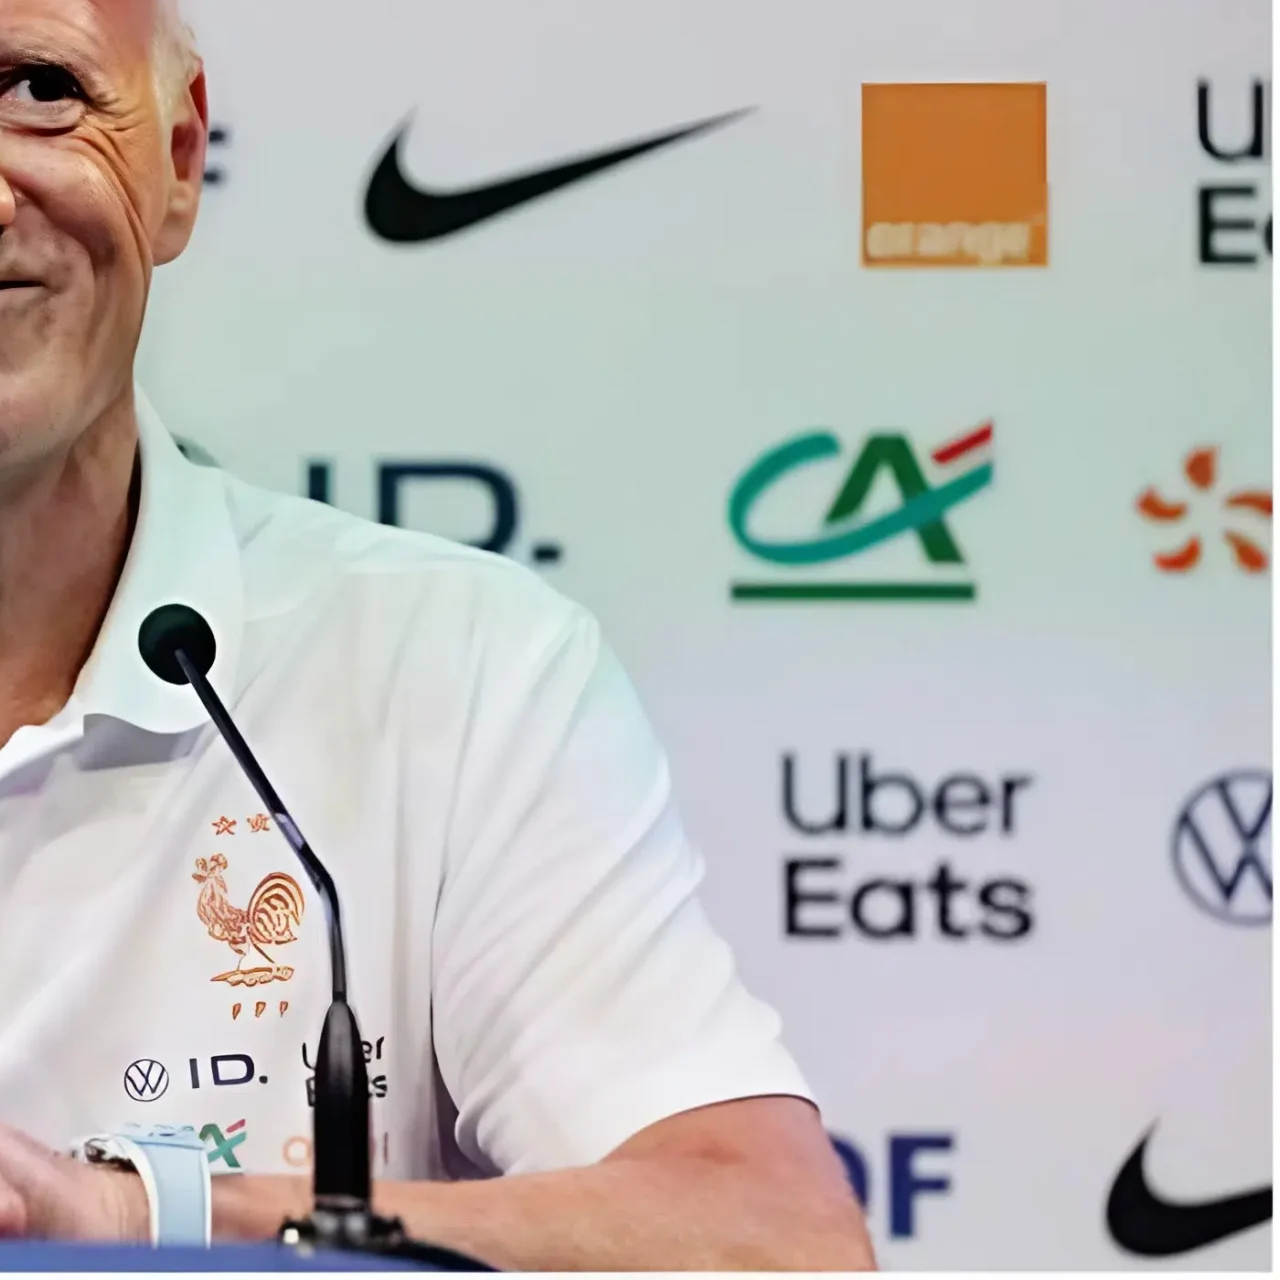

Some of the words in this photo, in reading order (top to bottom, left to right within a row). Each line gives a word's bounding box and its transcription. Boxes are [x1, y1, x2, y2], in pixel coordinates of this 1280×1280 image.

[783, 753, 1035, 835] Uber
[784, 858, 1035, 939] Eats
[188, 1053, 269, 1089] ID.
